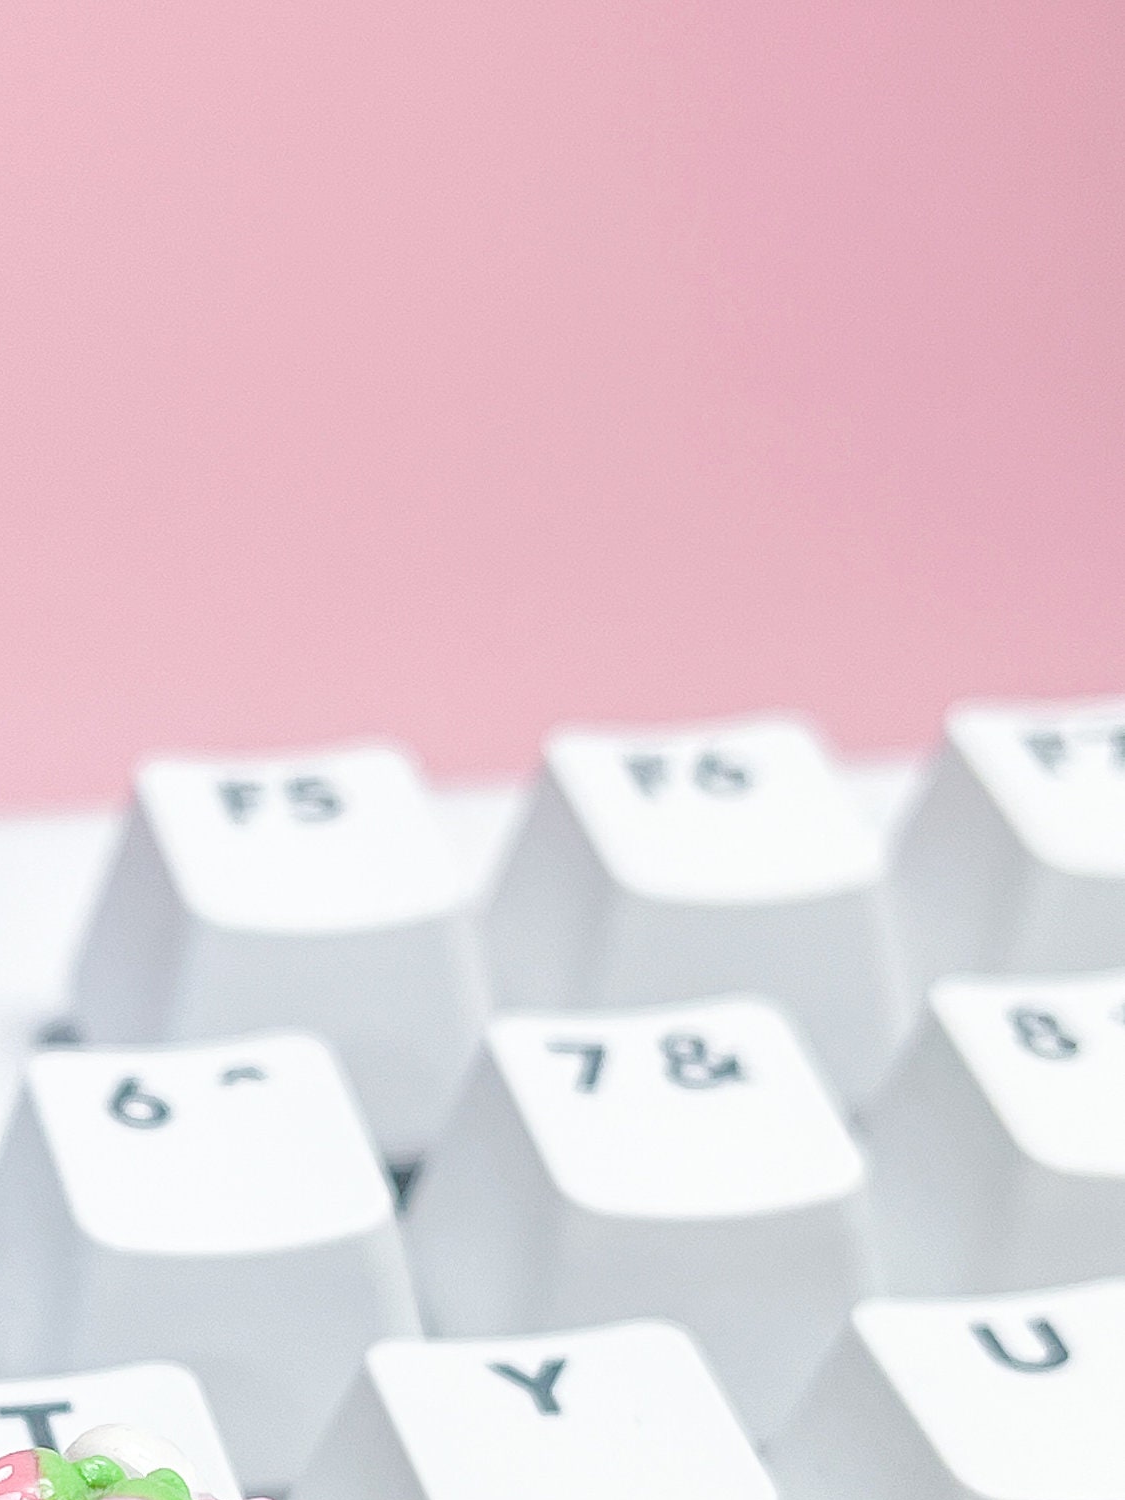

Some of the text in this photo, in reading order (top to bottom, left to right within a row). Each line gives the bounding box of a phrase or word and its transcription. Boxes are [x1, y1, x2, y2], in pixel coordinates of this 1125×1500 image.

[625, 752, 752, 796] F6
[1023, 727, 1125, 772] F
[218, 776, 344, 824] F5
[1009, 1008, 1080, 1059] 8
[547, 1035, 746, 1093] 7 &
[108, 1077, 171, 1129] 6
[973, 1318, 1070, 1373] U
[490, 1359, 566, 1415] Y
